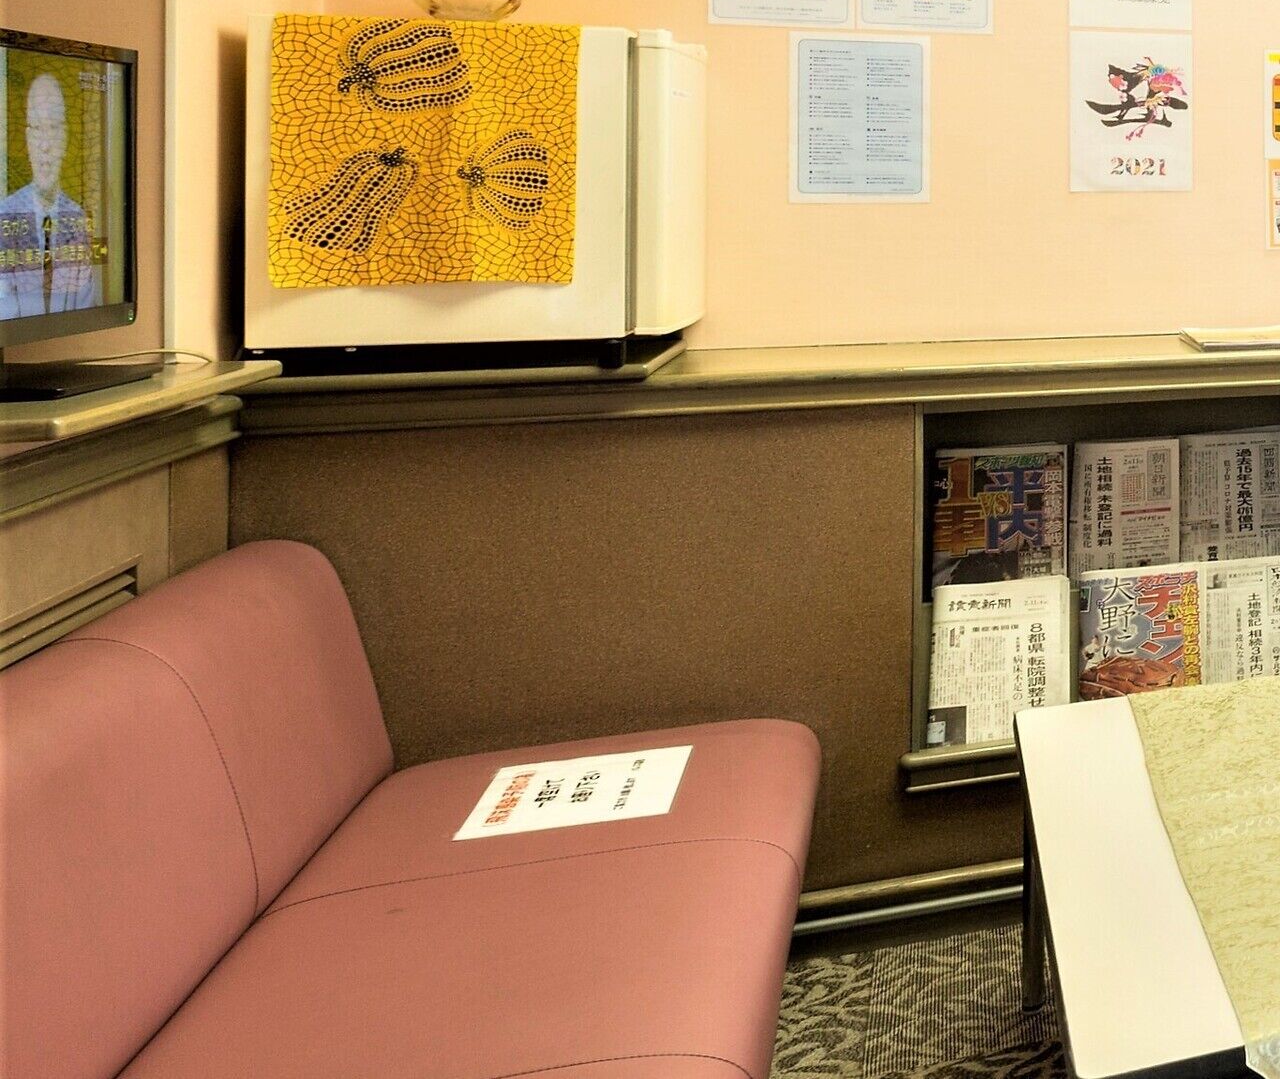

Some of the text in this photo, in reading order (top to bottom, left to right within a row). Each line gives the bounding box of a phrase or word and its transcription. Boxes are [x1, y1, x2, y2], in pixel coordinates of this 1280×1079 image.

[1110, 157, 1167, 176] 2021
[1097, 456, 1113, 492] 土地相続
[1151, 452, 1167, 497] 朝日新聞
[1134, 570, 1198, 593] スポニチ
[1098, 576, 1136, 659] 大野に
[1247, 592, 1262, 627] 土地登記
[1027, 622, 1046, 653] 8都県
[1027, 656, 1046, 707] 転院調整せ
